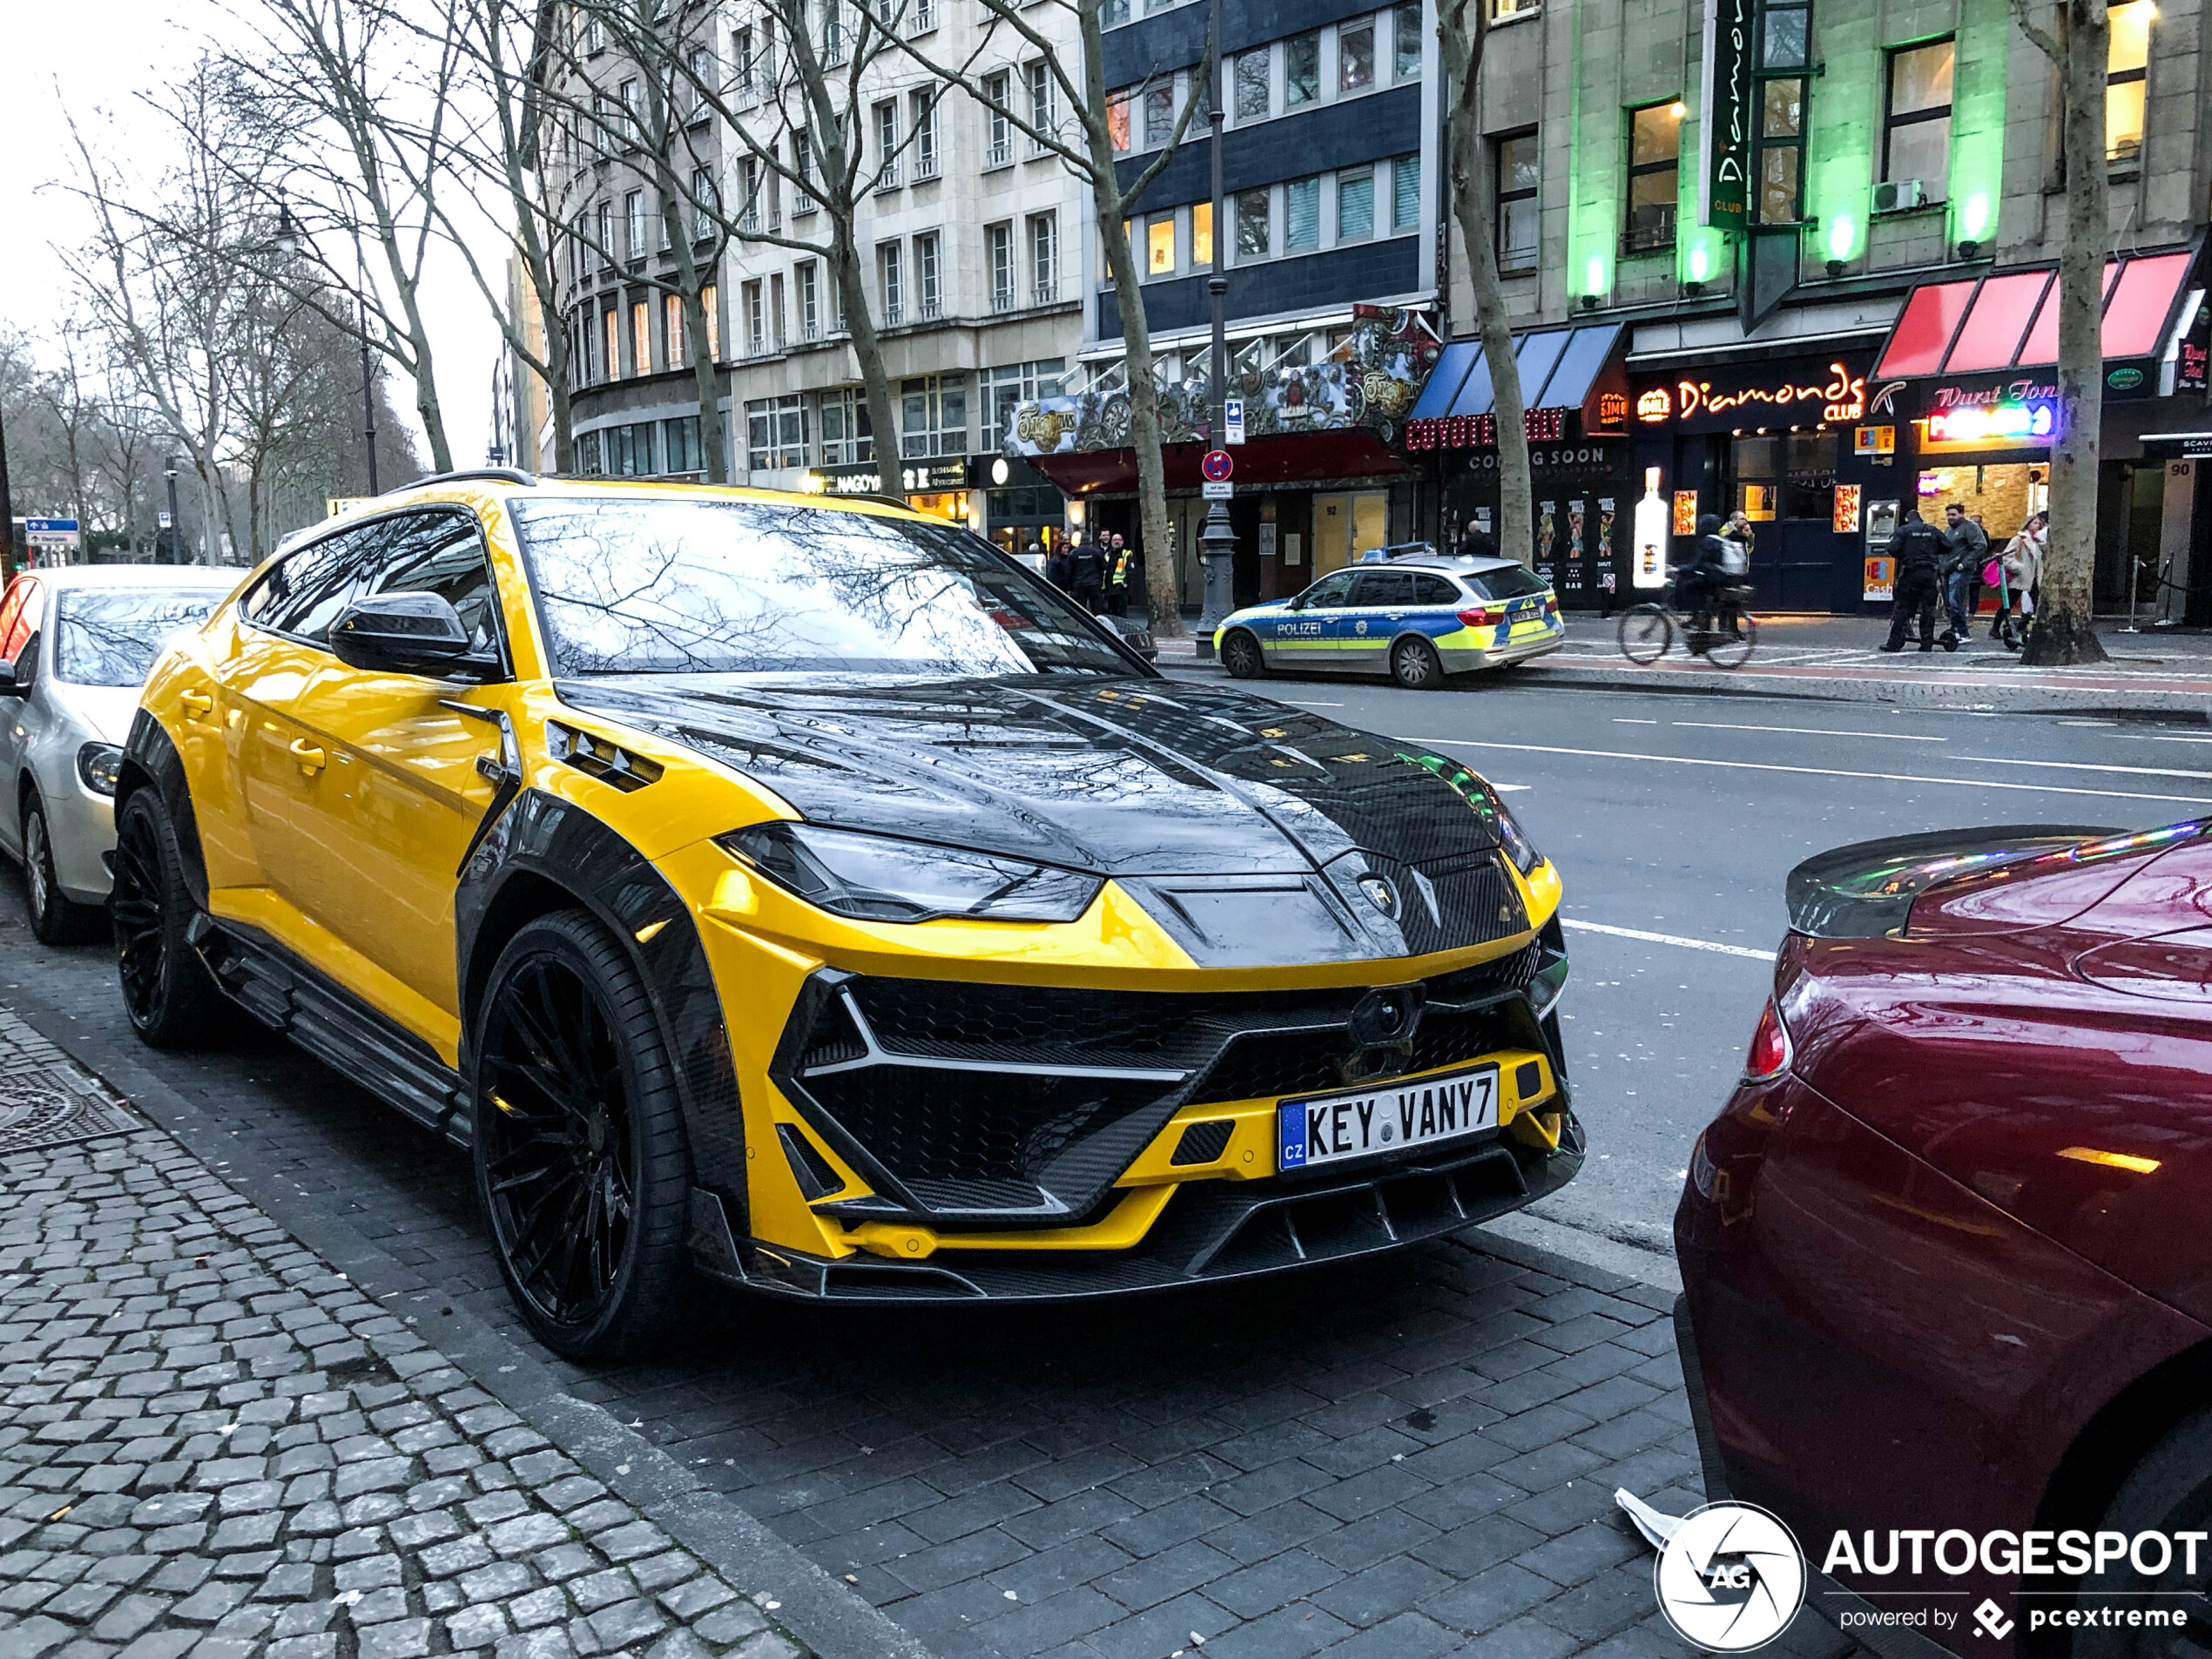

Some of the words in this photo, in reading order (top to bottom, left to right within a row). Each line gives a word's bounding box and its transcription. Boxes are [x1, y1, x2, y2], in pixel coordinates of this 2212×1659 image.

[1715, 199, 1742, 213] CLUB
[1678, 362, 1865, 419] Diamonds
[1934, 386, 2001, 408] Wurst
[1824, 402, 1864, 421] CLUB
[1406, 414, 1498, 451] COYOTE
[1524, 406, 1567, 442] GLY
[1469, 451, 1543, 469] COG
[1551, 448, 1604, 465] SOON
[2171, 463, 2190, 476] 90
[1326, 505, 1337, 516] 92
[1865, 583, 1893, 594] Cash
[1277, 621, 1321, 636] POLIZEI
[1308, 1099, 1375, 1157] KEY
[1399, 1077, 1493, 1141] VANY7
[1284, 1144, 1304, 1160] CZ
